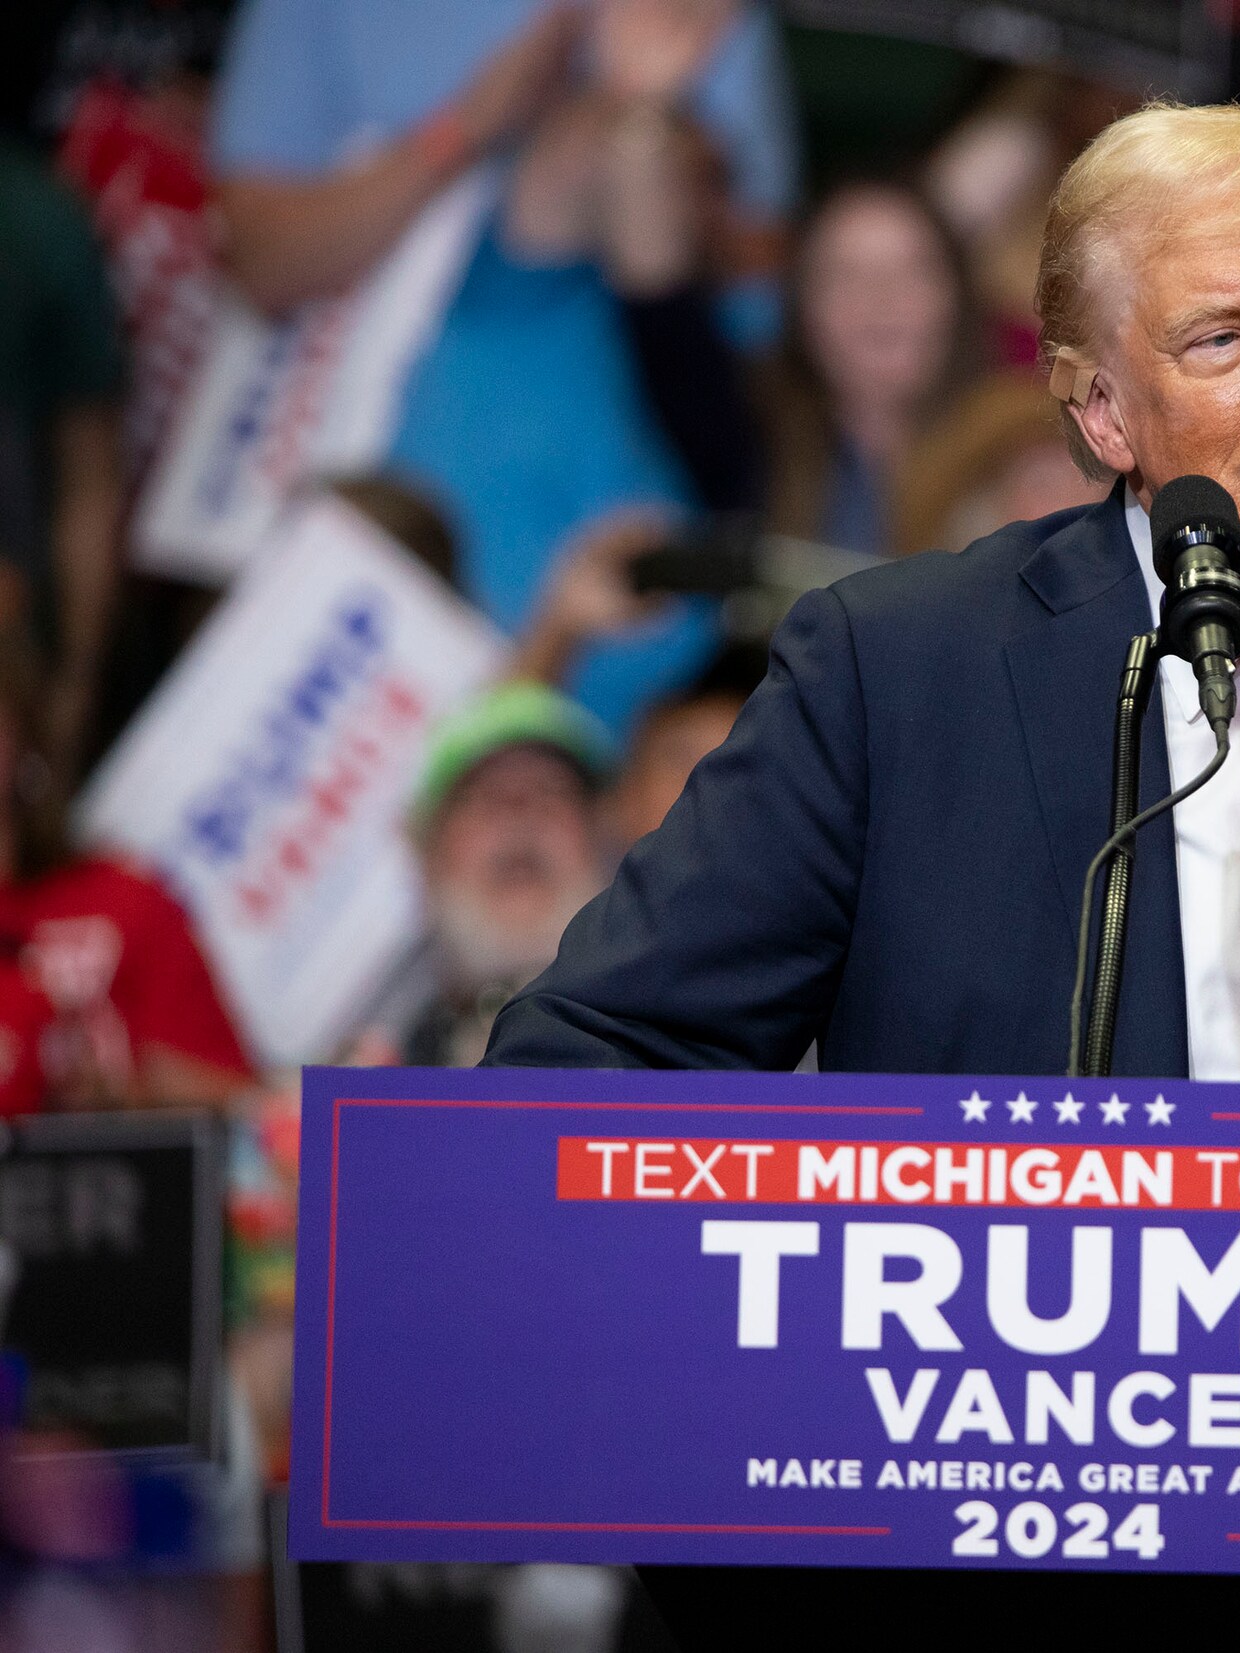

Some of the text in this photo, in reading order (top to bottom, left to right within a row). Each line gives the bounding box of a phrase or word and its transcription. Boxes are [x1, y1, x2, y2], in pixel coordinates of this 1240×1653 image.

[585, 1141, 776, 1200] TEXT
[796, 1144, 1175, 1207] MICHIGAN
[746, 1457, 863, 1489] MAKE
[875, 1459, 1065, 1492] AMERICA
[1078, 1462, 1214, 1495] GREAT
[951, 1499, 1166, 1561] 2024
